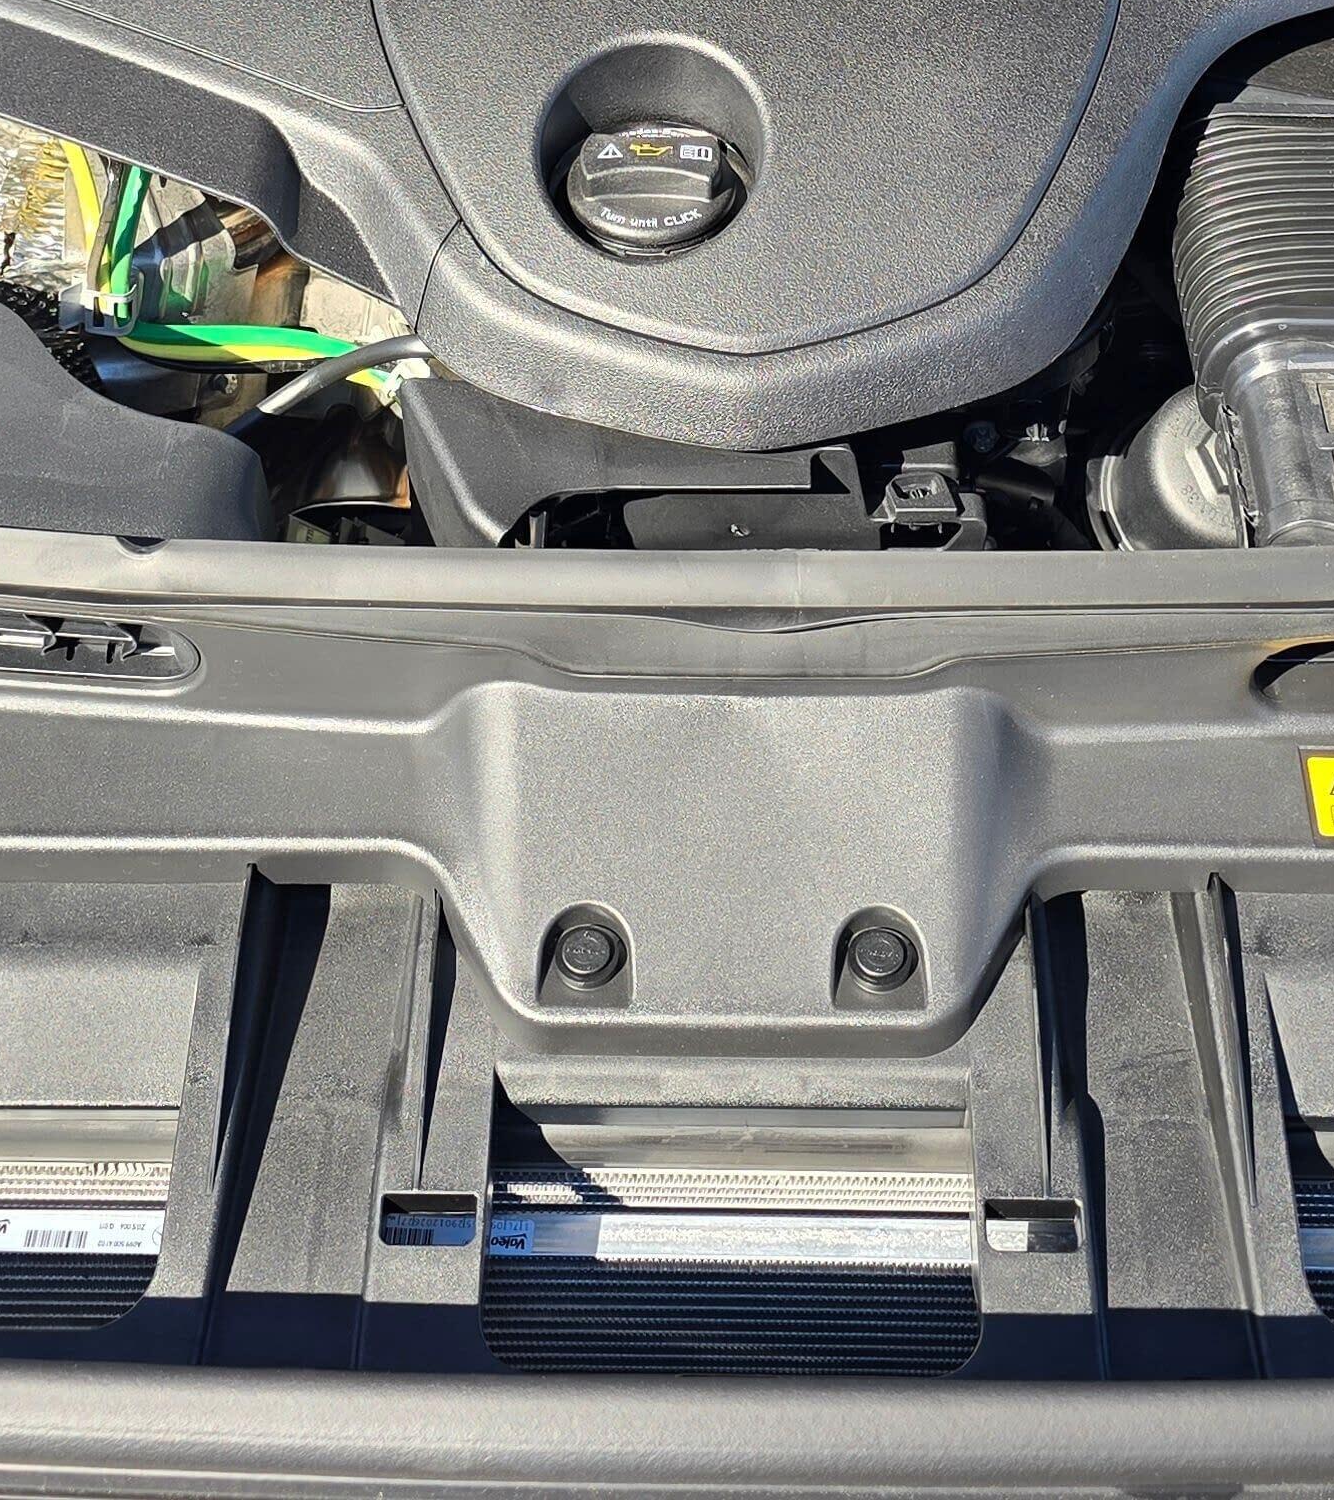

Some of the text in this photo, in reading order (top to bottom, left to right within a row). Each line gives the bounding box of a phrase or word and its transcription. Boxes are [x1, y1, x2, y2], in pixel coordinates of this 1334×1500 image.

[600, 206, 703, 228] Turn until CLICK
[491, 1235, 527, 1250] Valeo
